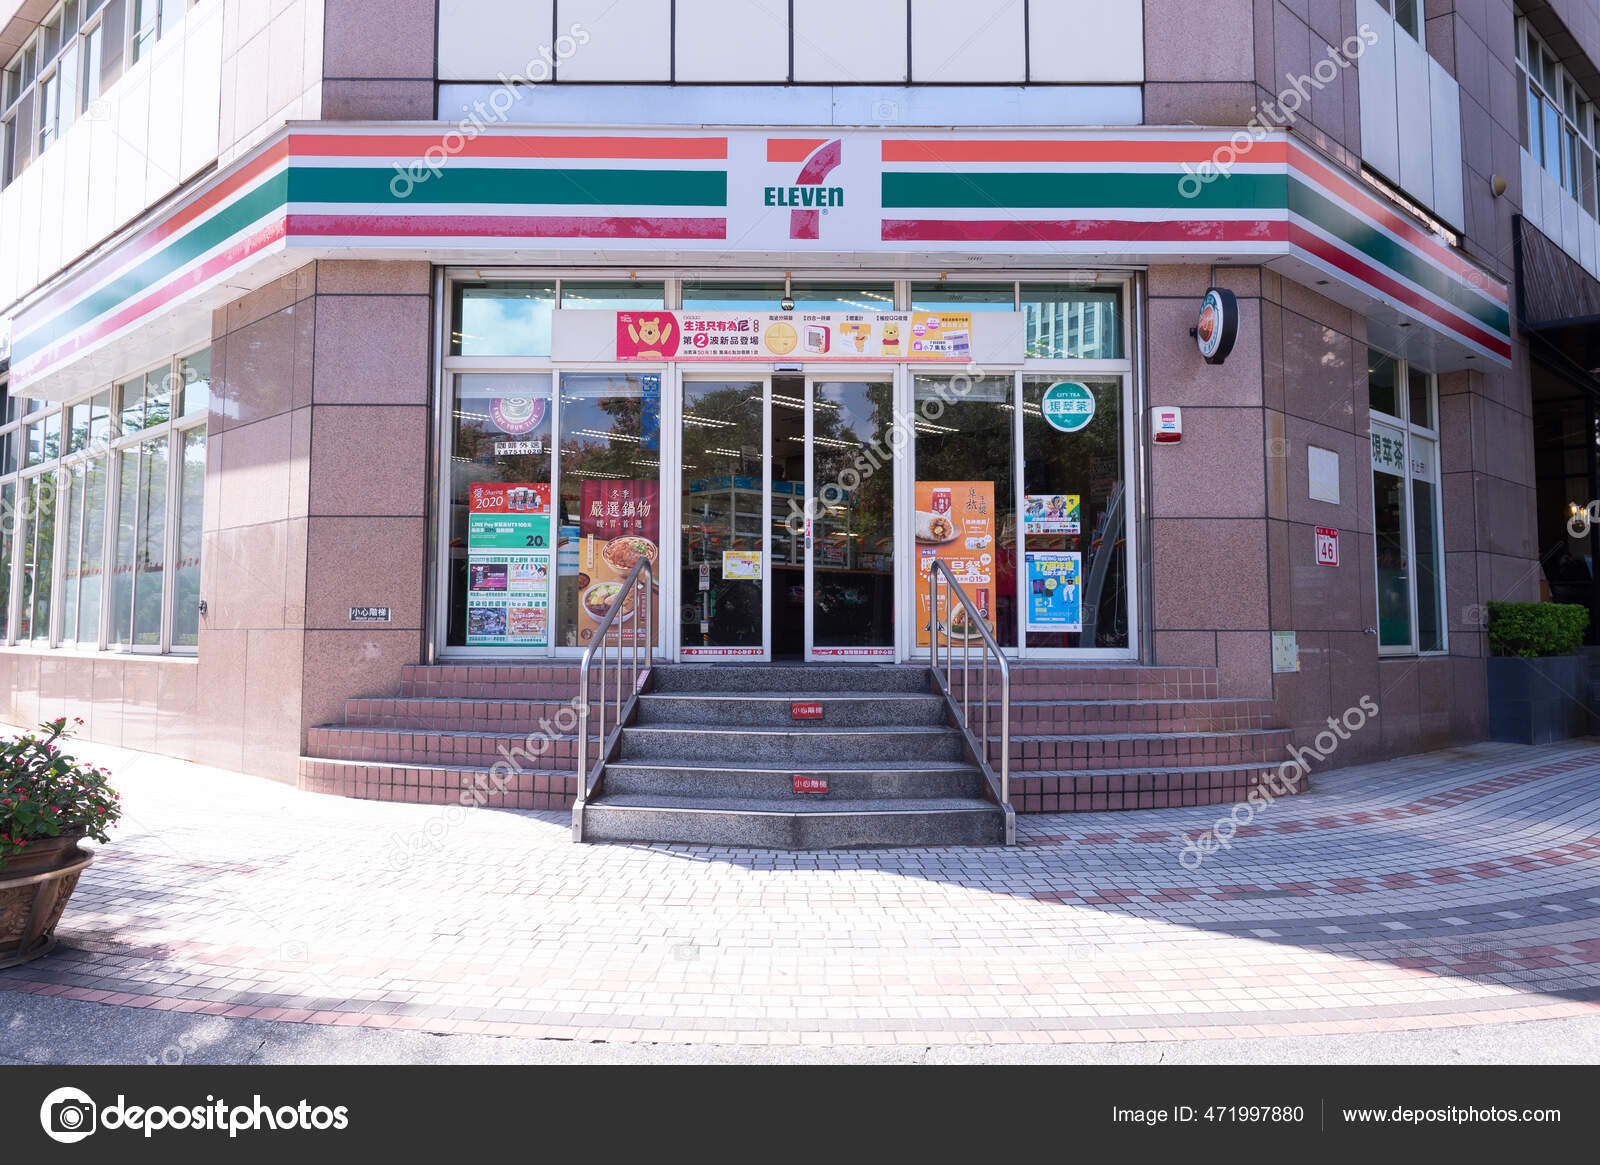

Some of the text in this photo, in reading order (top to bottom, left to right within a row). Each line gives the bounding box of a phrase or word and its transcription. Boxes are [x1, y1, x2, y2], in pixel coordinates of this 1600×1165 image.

[475, 496, 504, 509] 2020
[589, 500, 651, 517] 嚴選鍋物
[1321, 542, 1333, 560] 46
[352, 608, 387, 616] 小心階梯
